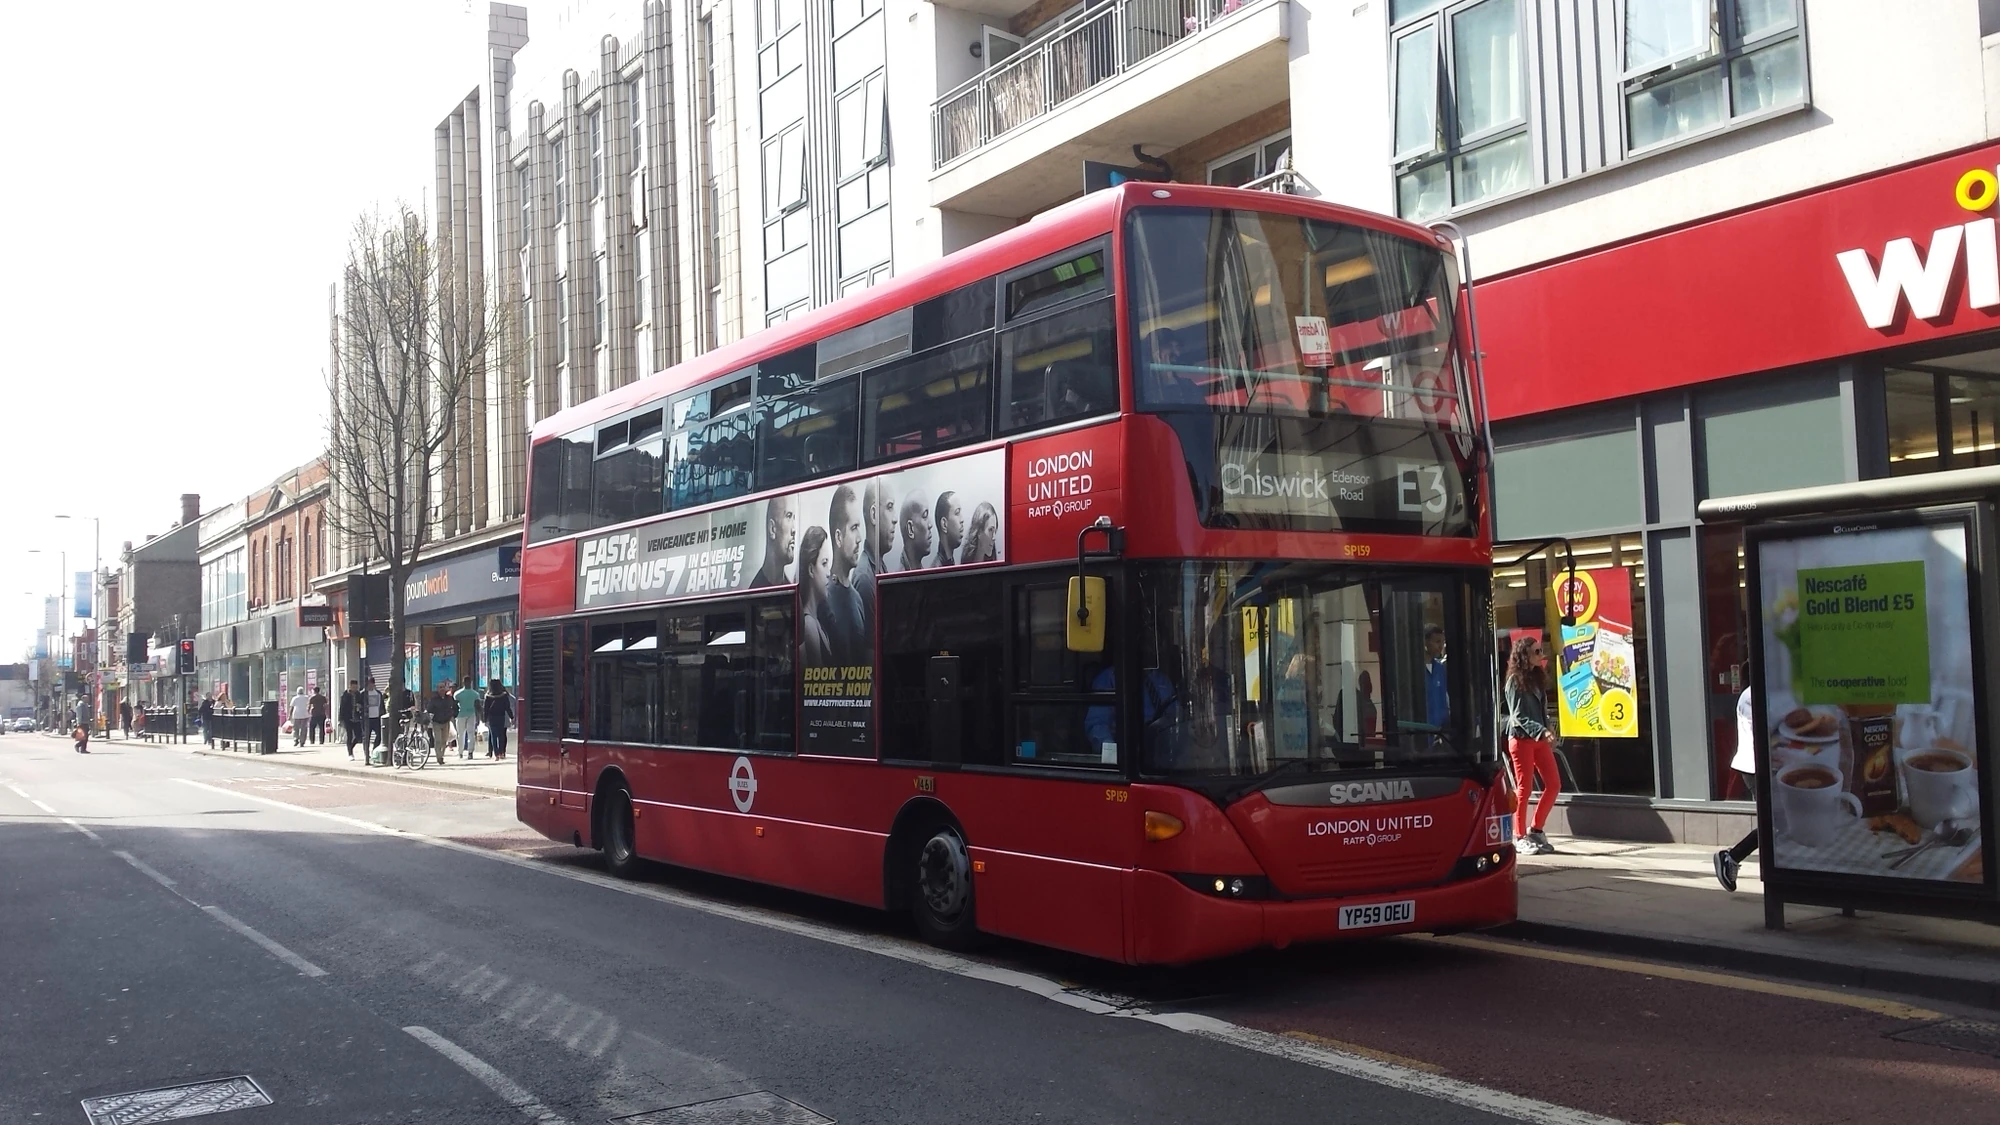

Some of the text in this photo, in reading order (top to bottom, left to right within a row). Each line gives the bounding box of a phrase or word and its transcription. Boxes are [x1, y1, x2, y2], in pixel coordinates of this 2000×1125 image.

[1029, 449, 1092, 478] LONDON
[1029, 474, 1092, 502] UNITED
[1332, 470, 1370, 485] Edensor
[1221, 463, 1447, 514] Chiswick E3
[1340, 488, 1364, 501] Road
[1029, 499, 1092, 518] RATP GROUP
[647, 531, 696, 552] VENGEANCE
[718, 521, 748, 540] HOME
[688, 545, 745, 569] IN CINEMAS
[1344, 545, 1370, 557] SP159
[406, 568, 449, 606] poundworld
[686, 562, 743, 593] APRIL 3
[1805, 573, 1867, 594] Nescafé
[1806, 593, 1915, 616] Gold Blend £5
[804, 666, 873, 681] BOOK YOUR
[1826, 676, 1886, 689] co-operative
[804, 682, 871, 696] TICKETS NOW
[1610, 703, 1624, 720] £3
[1864, 733, 1888, 743] GOLD
[1105, 789, 1128, 803] SP159
[1329, 780, 1415, 805] SCANIA
[1308, 814, 1433, 836] LONDON UNITED
[1343, 833, 1402, 845] RATP GROUP
[1345, 903, 1411, 926] YP59 OEU
